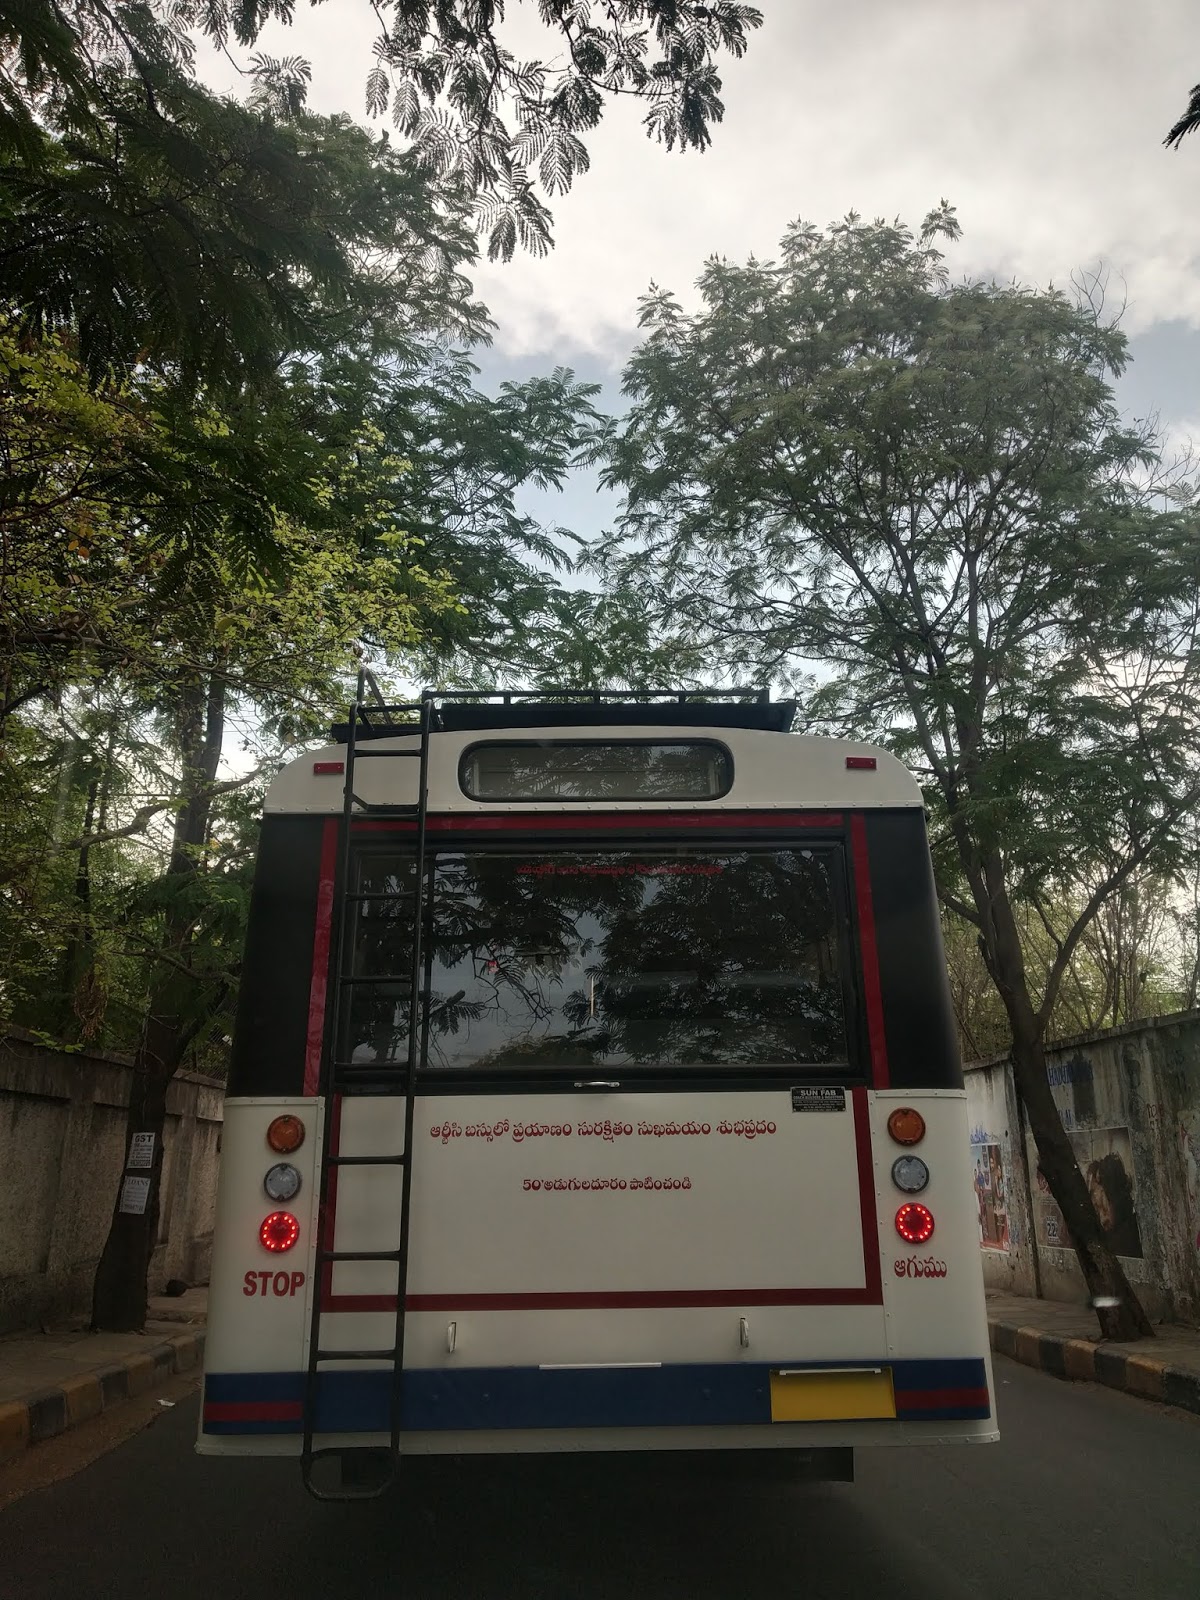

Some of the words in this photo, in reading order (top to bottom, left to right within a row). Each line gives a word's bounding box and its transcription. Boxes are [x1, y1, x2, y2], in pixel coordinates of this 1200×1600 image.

[135, 1134, 153, 1143] GST
[465, 1119, 509, 1142] బస్సులో
[512, 1123, 572, 1142] ప్రయాణం
[578, 1120, 633, 1142] సురక్షితం
[637, 1121, 711, 1137] సుఖమయం
[716, 1120, 776, 1139] శుభప్రదం
[630, 1177, 691, 1190] పాటించండి
[894, 1255, 947, 1278] ఆగుము
[243, 1271, 305, 1296] STOP
